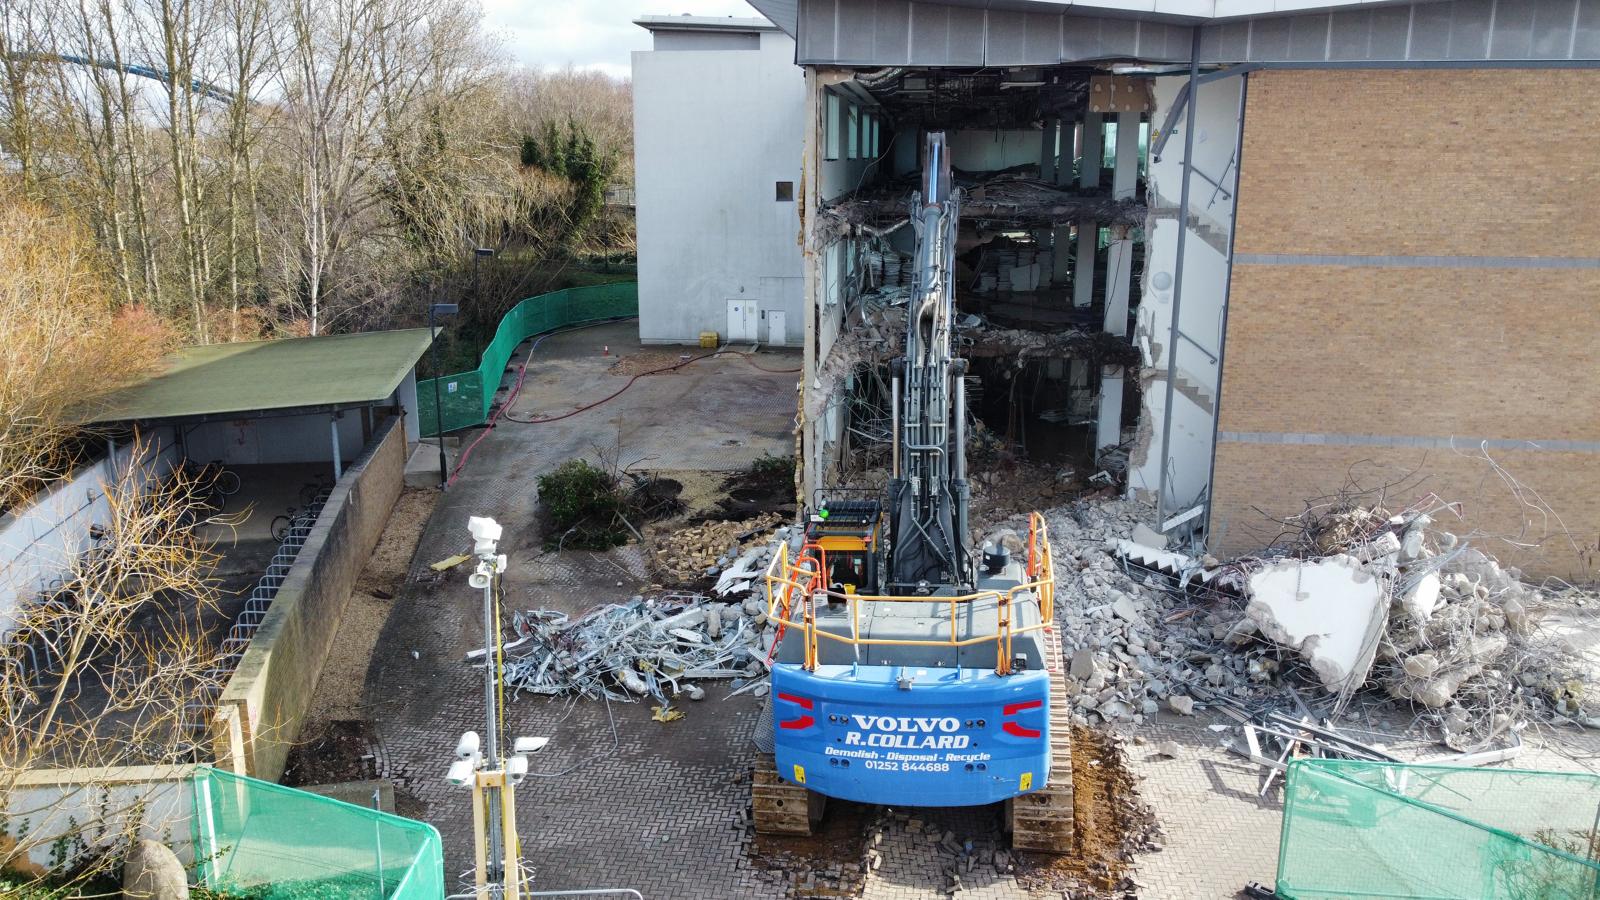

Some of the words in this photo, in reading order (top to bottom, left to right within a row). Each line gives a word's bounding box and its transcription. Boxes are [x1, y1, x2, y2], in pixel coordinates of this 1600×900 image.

[852, 714, 960, 732] VOLVO
[845, 731, 969, 749] R.COLLARD
[825, 746, 879, 760] Demolish
[887, 753, 938, 762] Disposal
[945, 752, 991, 763] Recycle
[865, 760, 899, 771] 01252
[901, 761, 950, 772] 844688
